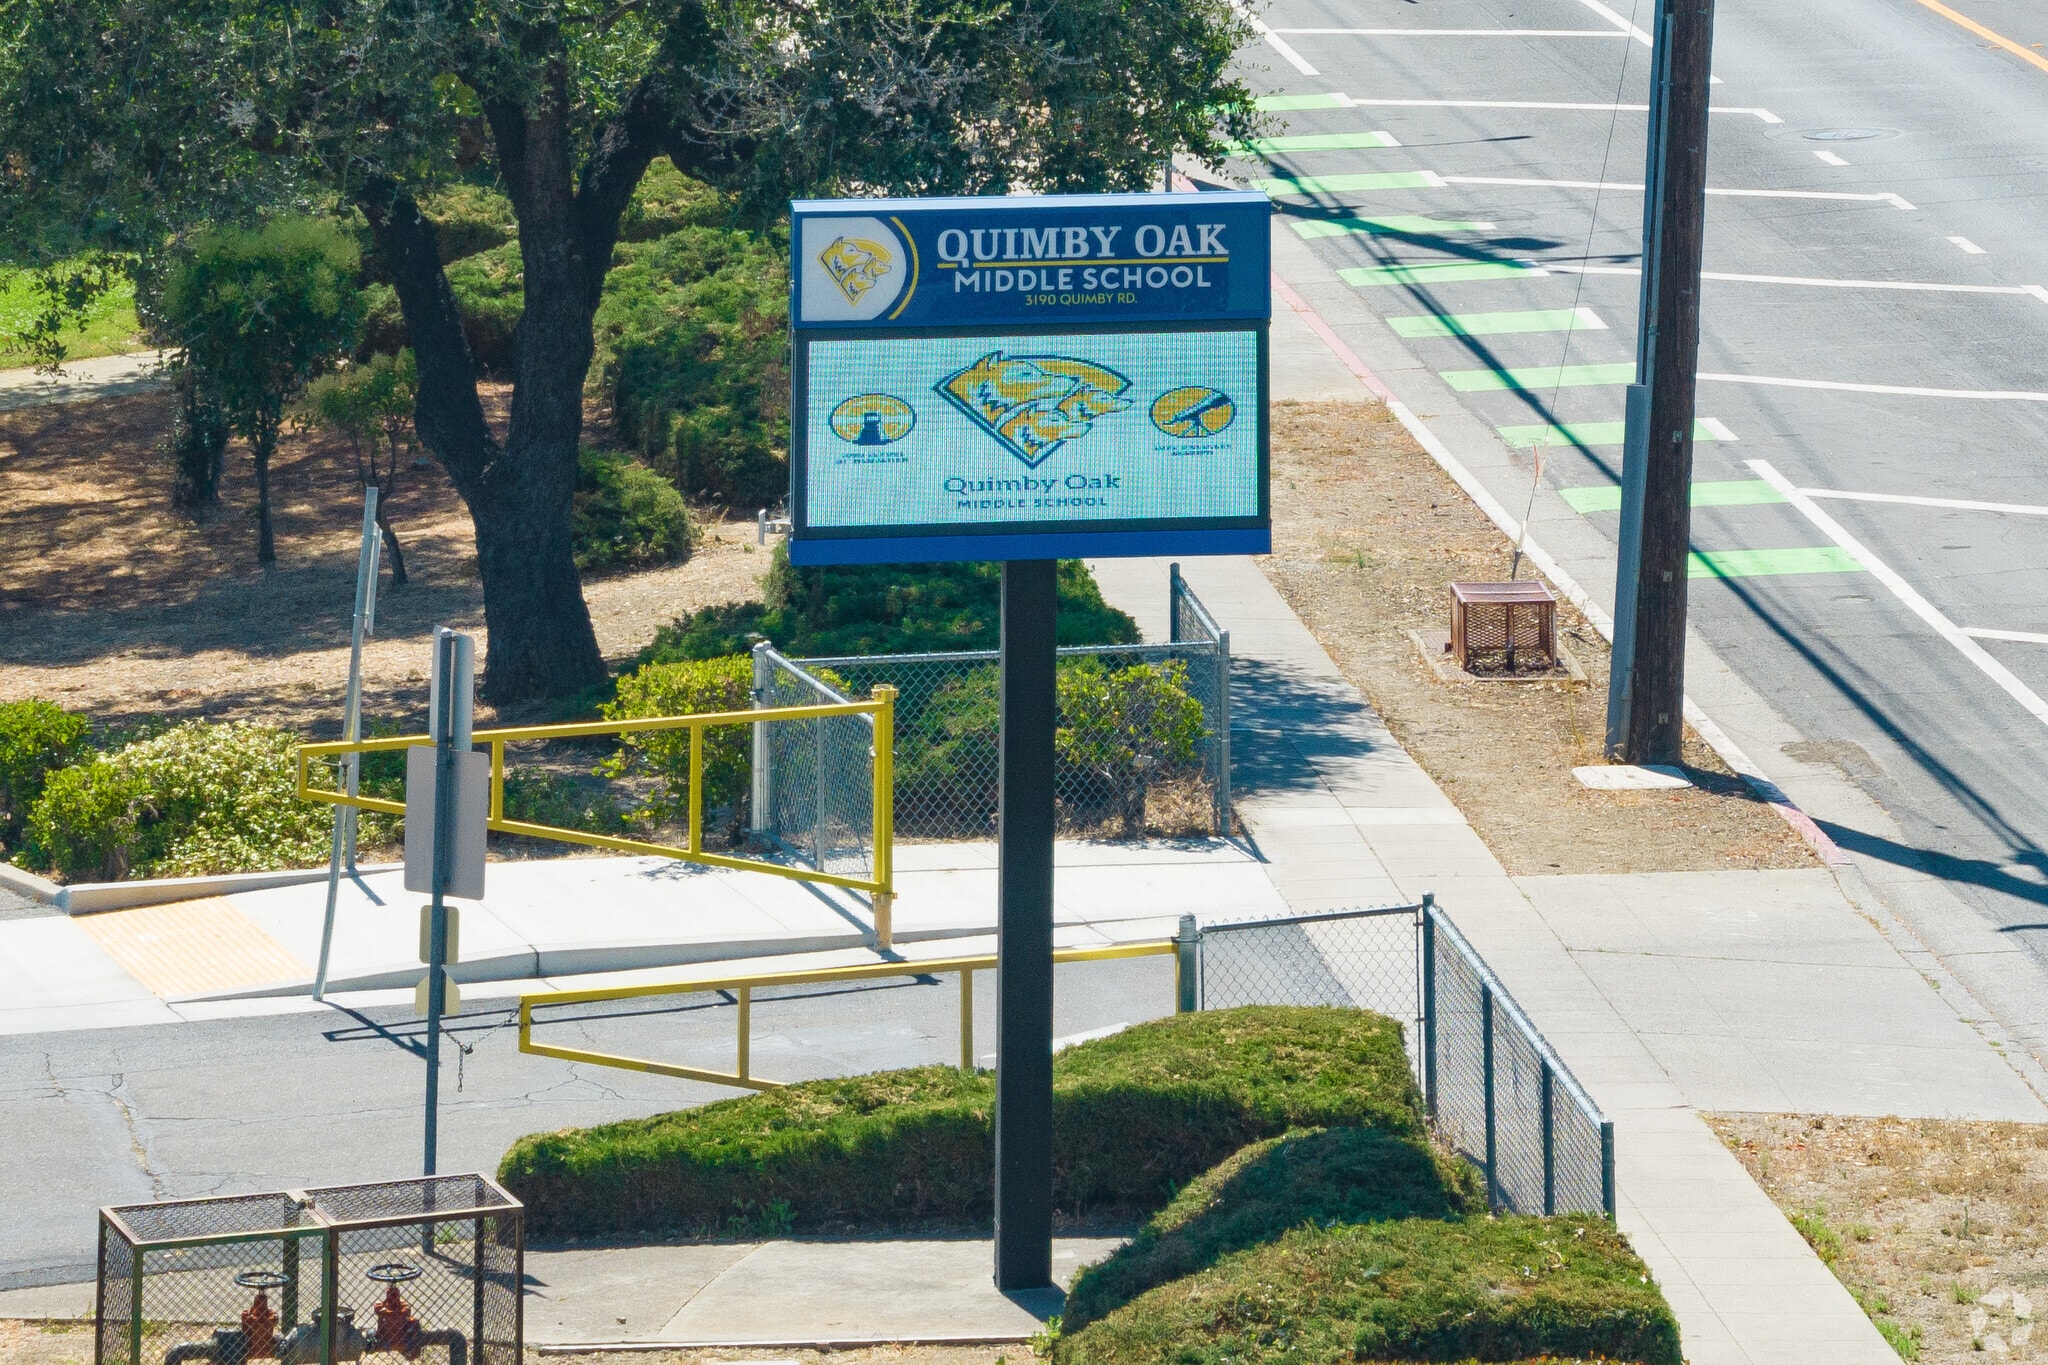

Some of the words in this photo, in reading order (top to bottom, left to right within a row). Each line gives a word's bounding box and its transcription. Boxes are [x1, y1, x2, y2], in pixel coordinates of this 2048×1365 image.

[937, 226, 1121, 267] QUIMBY
[1134, 223, 1229, 257] OAK
[955, 268, 1074, 293] MIDDLE
[1083, 266, 1212, 290] SCHOOL
[1025, 294, 1057, 306] 3190
[1060, 293, 1115, 306] QUIMBY
[1117, 292, 1138, 304] RD.
[944, 476, 1058, 495] Quimby
[1065, 474, 1121, 490] Oak
[957, 498, 1026, 510] MIDDLE
[1034, 497, 1108, 509] SCHOOL
